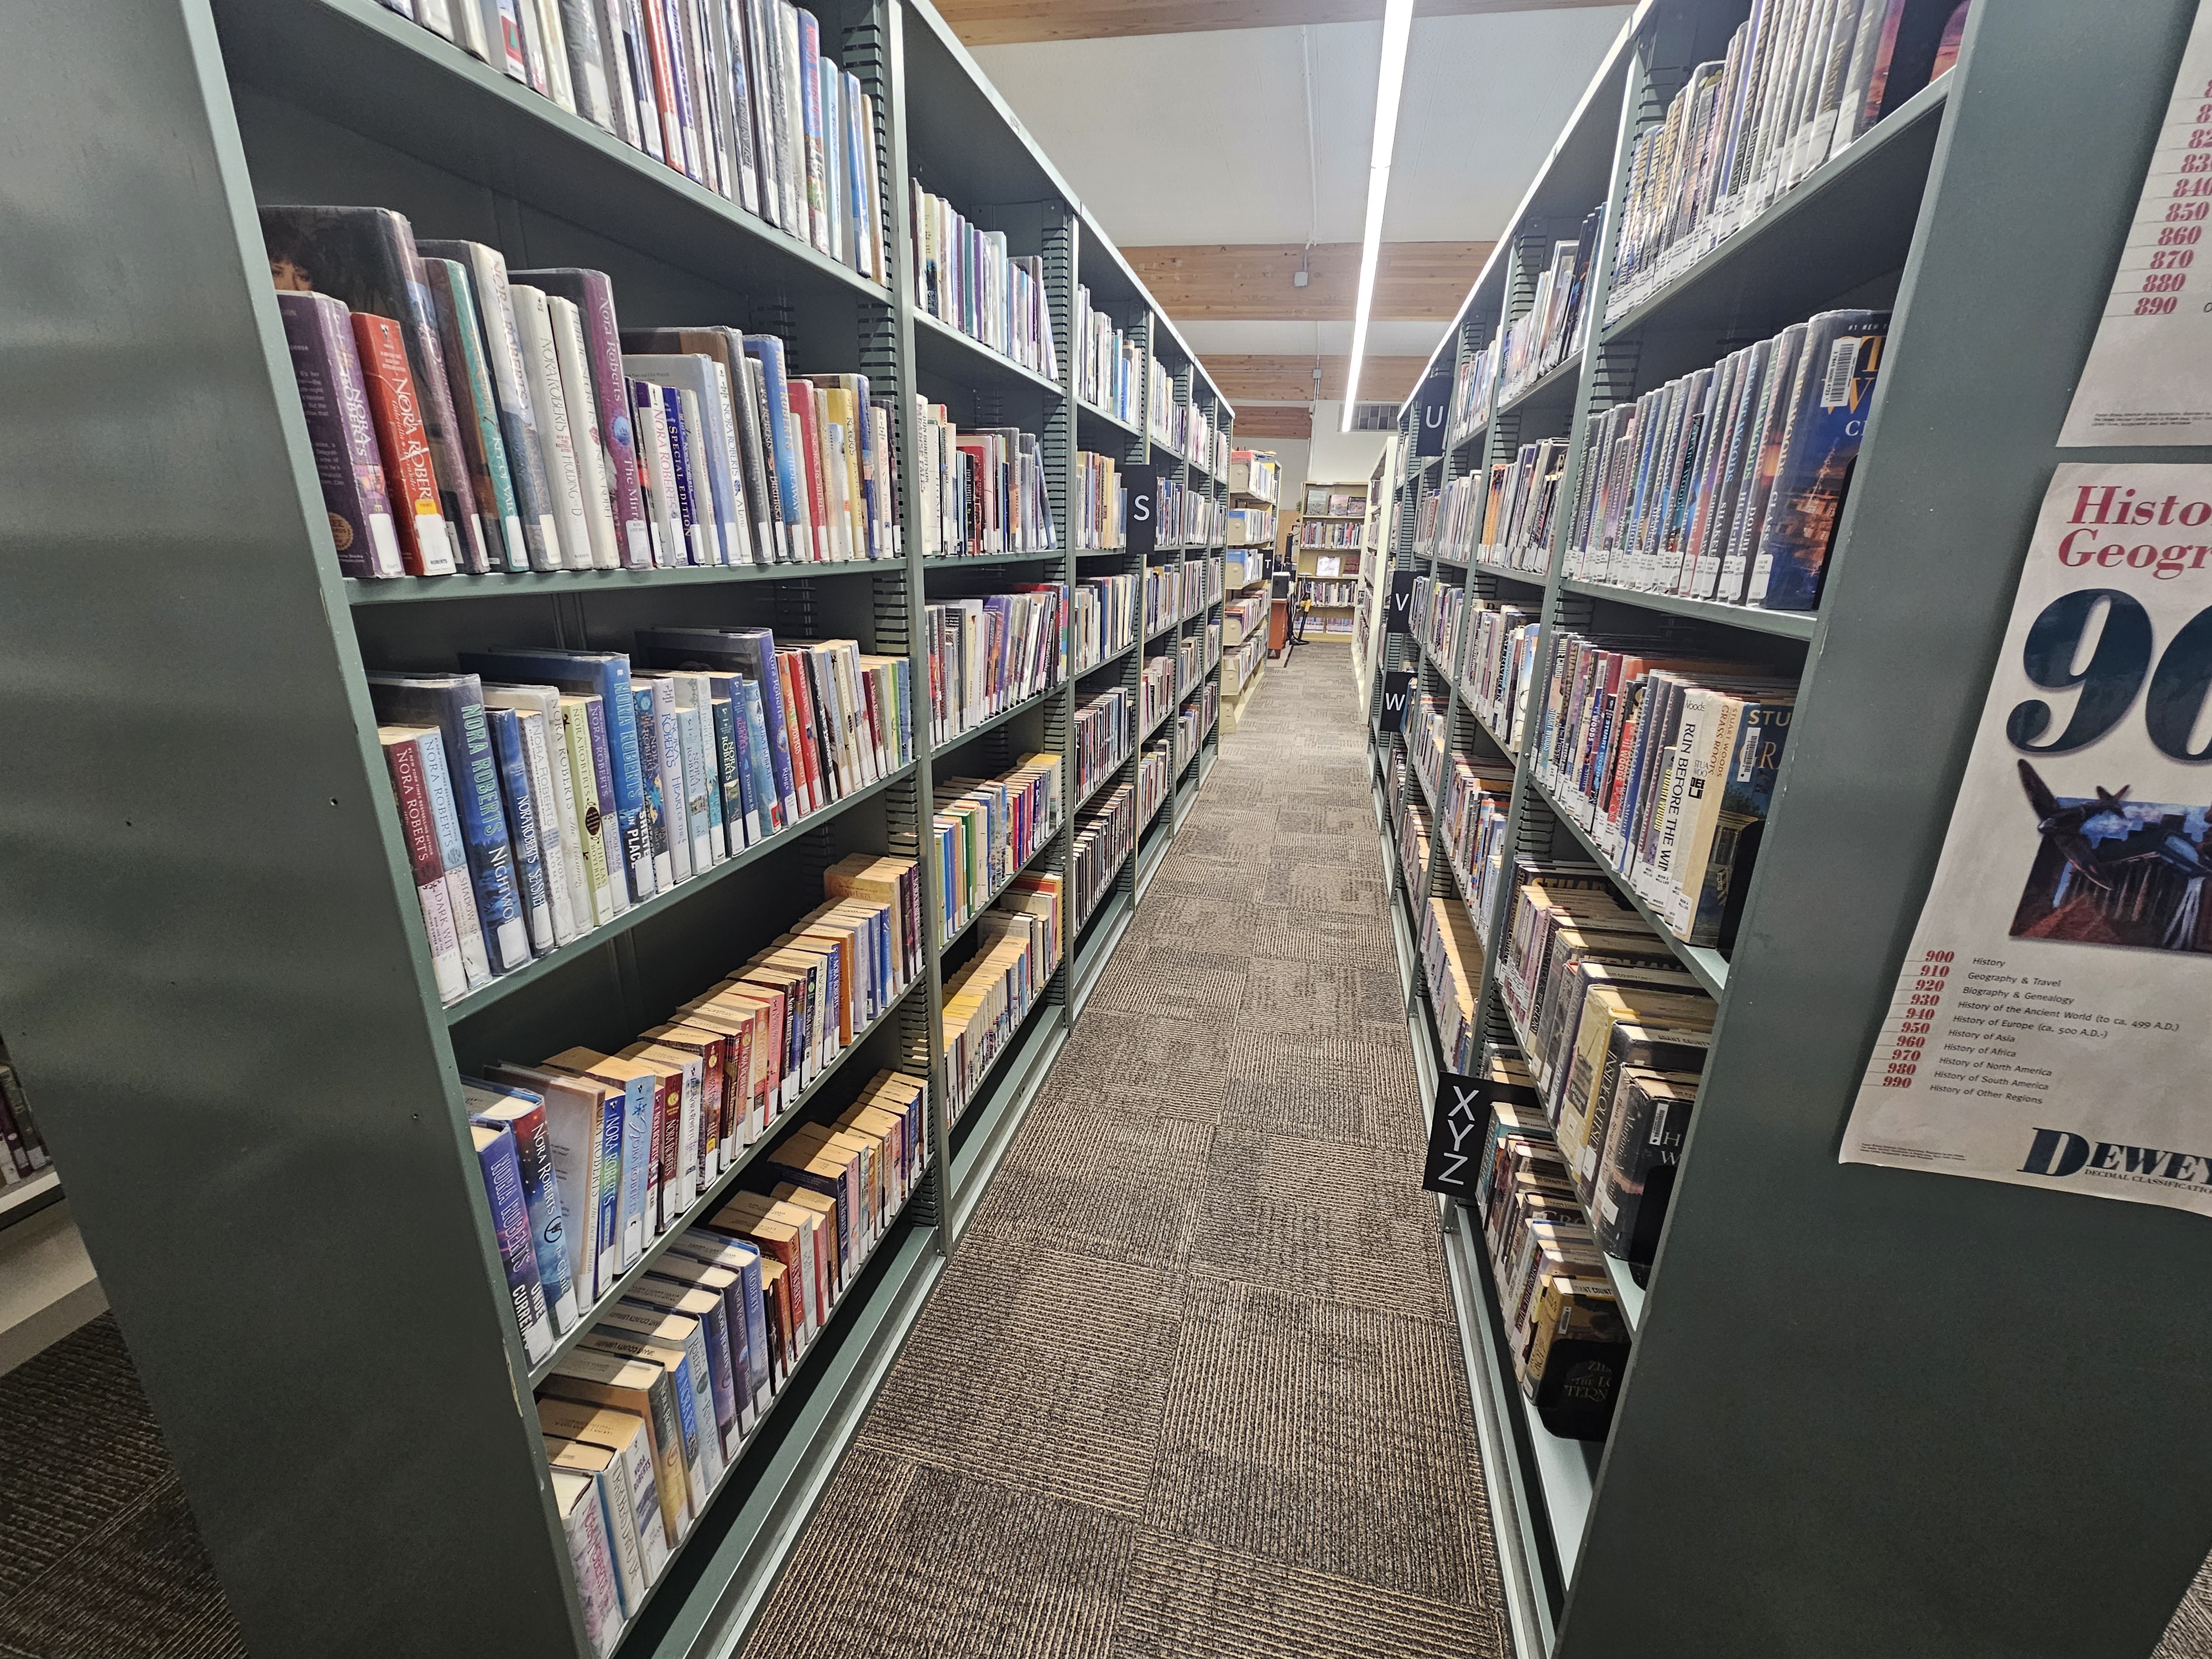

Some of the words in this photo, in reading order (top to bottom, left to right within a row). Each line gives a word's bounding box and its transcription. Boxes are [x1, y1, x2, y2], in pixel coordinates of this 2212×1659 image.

[2181, 153, 2212, 173] 83
[2173, 178, 2212, 197] 840
[2165, 202, 2210, 222] 850
[2158, 226, 2202, 246] 860
[2150, 249, 2194, 269] 870
[2142, 273, 2186, 292] 880
[600, 297, 614, 340] Nora
[2134, 296, 2178, 315] 890
[539, 337, 557, 380] NORA
[606, 341, 623, 402] Roberts
[775, 349, 786, 387] NORA
[340, 372, 366, 457] ROBERTS
[351, 389, 372, 443] NORA
[392, 377, 422, 435] NORA
[723, 403, 733, 435] NORA
[1426, 406, 1443, 429] U
[727, 434, 739, 476] ROBERTS
[1726, 421, 1745, 483] WOODS
[1743, 421, 1764, 479] WOODS
[1777, 406, 1798, 476] WOODS
[623, 457, 634, 484] The
[653, 409, 665, 448] NORA
[659, 447, 677, 509] ROBERTS
[668, 425, 683, 480] SPECIAL
[679, 484, 692, 537] EDITION
[1133, 495, 1150, 521] S
[1762, 491, 1778, 541] CLASS
[2067, 485, 2212, 526] Histo
[1396, 593, 1410, 612] V
[614, 681, 634, 727] NORA
[1386, 693, 1405, 711] W
[461, 703, 489, 755] NORA
[591, 707, 601, 743] NORA
[1601, 719, 1610, 750] STUART
[1679, 722, 1696, 754] RUN
[1716, 704, 1730, 738] GRASS
[1727, 707, 1738, 742] STUART
[552, 699, 564, 742] NORA
[559, 747, 574, 810] ROBERTS
[573, 708, 582, 743] NORA
[578, 746, 591, 797] ROBERTS
[661, 713, 676, 768] ROBERTS
[671, 718, 680, 760] NORA
[595, 747, 608, 797] ROBERTS
[620, 729, 642, 801] ROBERTS
[722, 735, 733, 781] ROBERTS
[727, 742, 737, 774] NORA
[1594, 752, 1605, 780] WOODS
[1615, 749, 1629, 781] WOODS
[1708, 740, 1721, 776] ROOTS
[1716, 744, 1730, 778] WOODS
[532, 724, 544, 763] NORA
[539, 766, 555, 827] ROBERTS
[1667, 758, 1689, 816] BEFORE
[397, 749, 414, 794] NORA
[406, 799, 429, 861] ROBERTS
[425, 739, 440, 782] NORA
[434, 787, 453, 847] ROBERTS
[471, 756, 504, 837] ROBERTS
[517, 795, 533, 825] NORA
[671, 776, 683, 812] HEART
[610, 822, 619, 852] BLOOD
[1662, 812, 1679, 846] THE
[549, 852, 562, 900] MOMENT
[555, 850, 565, 882] SAVOR
[459, 877, 476, 924] SHADOW
[489, 846, 515, 924] NIGHTWO
[435, 892, 448, 926] DARK
[1920, 964, 1950, 977] 910
[1925, 950, 1955, 963] 900
[1973, 957, 2006, 968] History
[1915, 979, 1945, 992] 920
[1963, 987, 2010, 999] Biography
[2025, 993, 2075, 1005] Genealogy
[1968, 972, 2017, 984] Geography
[2033, 978, 2062, 987] Travel
[1906, 1008, 1935, 1020] 940
[1911, 994, 1940, 1006] 930
[1958, 1001, 1990, 1012] History
[2025, 1008, 2060, 1018] Ancient
[2064, 1011, 2093, 1021] World
[2096, 1014, 2110, 1024] (to
[2154, 1022, 2179, 1032] A.D.)
[1658, 1034, 1681, 1044] GRANT
[1896, 1035, 1926, 1048] 960
[1901, 1021, 1930, 1034] 950
[1948, 1030, 1980, 1040] History
[1995, 1034, 2016, 1042] Asia
[1953, 1015, 1985, 1026] History
[2001, 1020, 2034, 1030] Europe
[2038, 1023, 2054, 1032] (ca.
[2080, 1029, 2108, 1039] A.D.-)
[1892, 1049, 1921, 1061] 970
[1939, 1057, 1970, 1067] History
[1986, 1062, 2012, 1072] North
[2015, 1065, 2052, 1076] America
[1944, 1043, 1976, 1053] History
[1990, 1048, 2017, 1057] Africa
[1600, 1050, 1618, 1095] INSIDE
[1882, 1076, 1912, 1088] 990
[1887, 1062, 1917, 1075] 980
[1934, 1071, 1965, 1081] History
[1981, 1076, 2008, 1086] South
[2012, 1079, 2048, 1090] America
[1448, 1085, 1480, 1121] X
[1929, 1084, 1961, 1094] History
[1976, 1089, 2002, 1099] Other
[2005, 1093, 2043, 1104] Regions
[531, 1123, 547, 1165] NORA
[604, 1115, 620, 1153] NORA
[1448, 1119, 1475, 1151] Y
[491, 1152, 517, 1206] NORA
[603, 1152, 619, 1207] ROBERTS
[1438, 1152, 1468, 1185] Z
[2085, 1168, 2130, 1181] DECIMAL
[538, 1161, 556, 1215] ROBERTS
[501, 1196, 532, 1274] ROBERTS
[748, 1269, 759, 1313] ROBERTS
